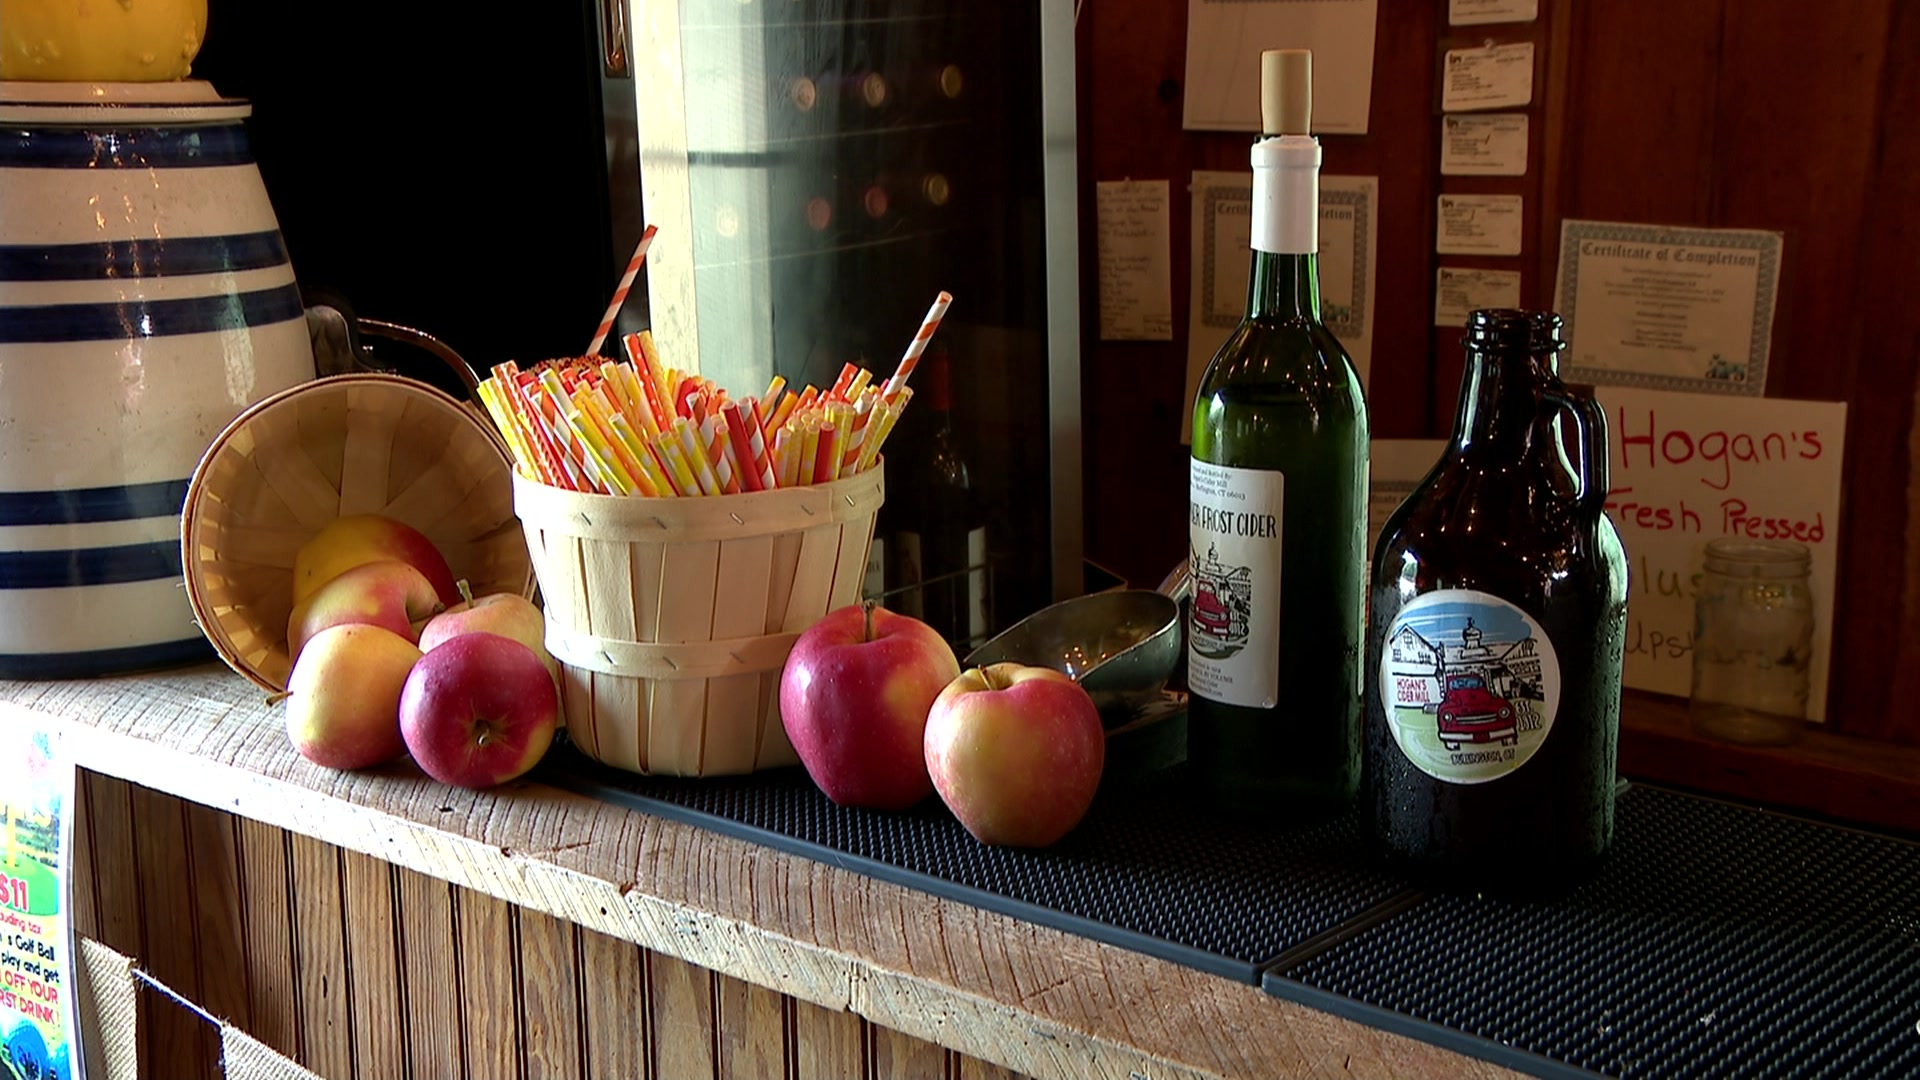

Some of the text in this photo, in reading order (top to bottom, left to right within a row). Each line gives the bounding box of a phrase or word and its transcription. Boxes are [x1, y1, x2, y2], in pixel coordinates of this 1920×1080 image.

[1581, 241, 1757, 267] Certificate of Completion
[1619, 406, 1823, 490] Hogan's
[1191, 502, 1277, 539] ER FROST CIDER
[1720, 498, 1825, 543] Pressed
[1397, 678, 1427, 691] HOGAN'S
[1397, 690, 1431, 703] CIDER MILL
[28, 920, 42, 935] tax
[15, 934, 35, 954] Golf
[37, 941, 55, 961] Ball
[1, 950, 60, 983] play and get
[4, 969, 59, 1005] OFF YOUR
